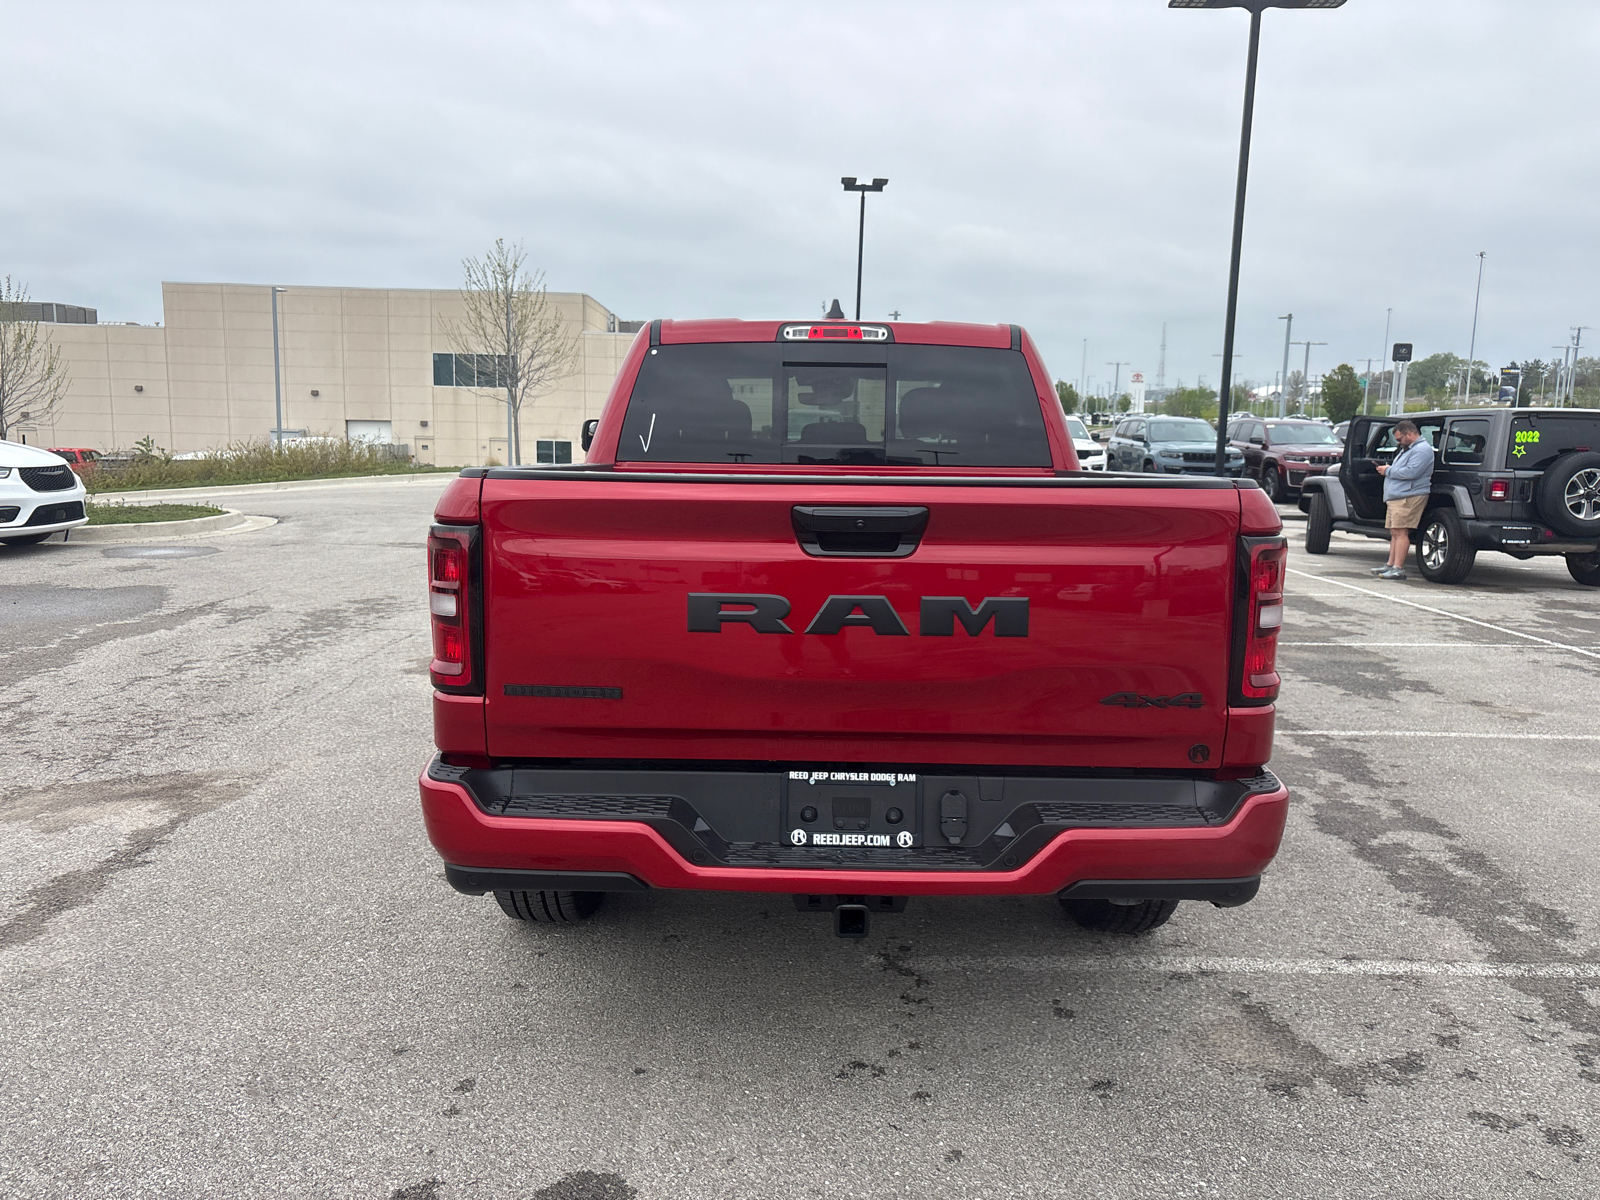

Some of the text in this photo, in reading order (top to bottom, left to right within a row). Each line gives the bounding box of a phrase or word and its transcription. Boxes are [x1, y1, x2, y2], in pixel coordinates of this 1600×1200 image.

[1515, 430, 1540, 443] 2022
[687, 592, 1030, 638] RAM
[789, 771, 917, 782] REED JEEP CHRYSLER DODGE RAM
[813, 834, 891, 846] REEDJEEP.COM
